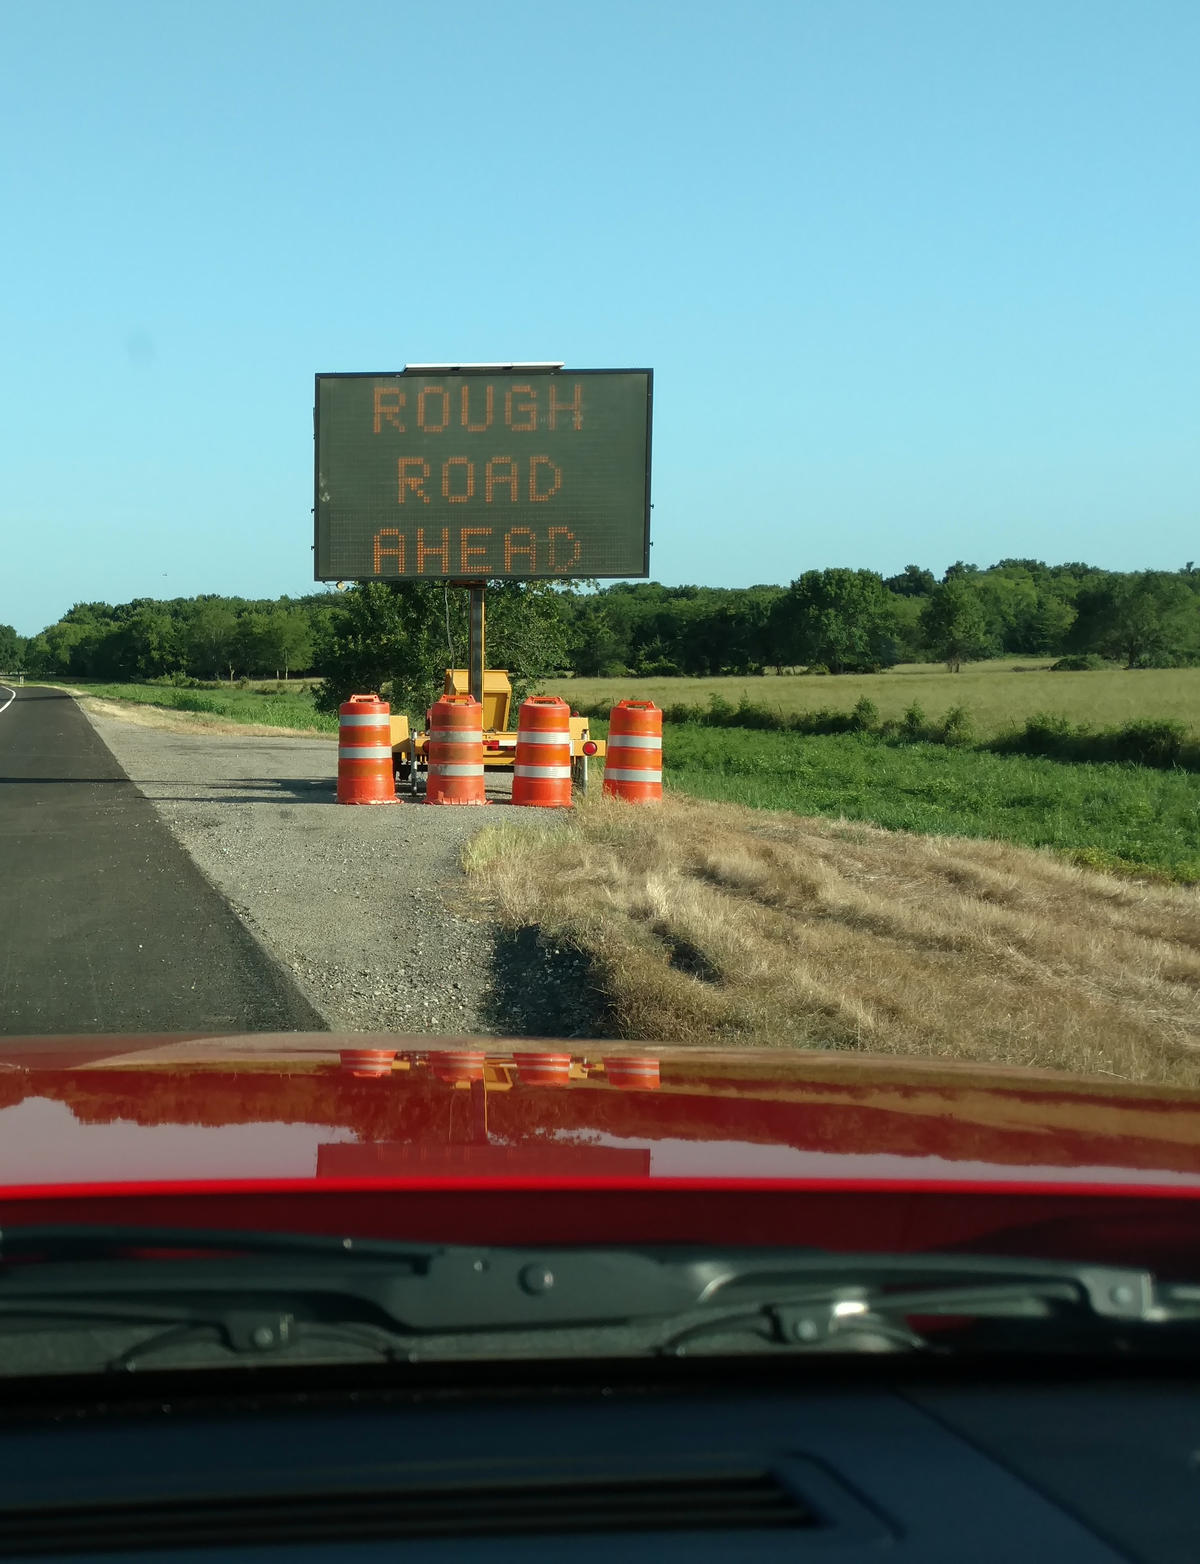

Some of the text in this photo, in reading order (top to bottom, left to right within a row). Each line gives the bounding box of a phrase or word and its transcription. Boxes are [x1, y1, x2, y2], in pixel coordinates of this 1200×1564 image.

[373, 384, 583, 433] ROUGH
[397, 456, 562, 503] ROAD
[373, 526, 582, 574] AHEAD
